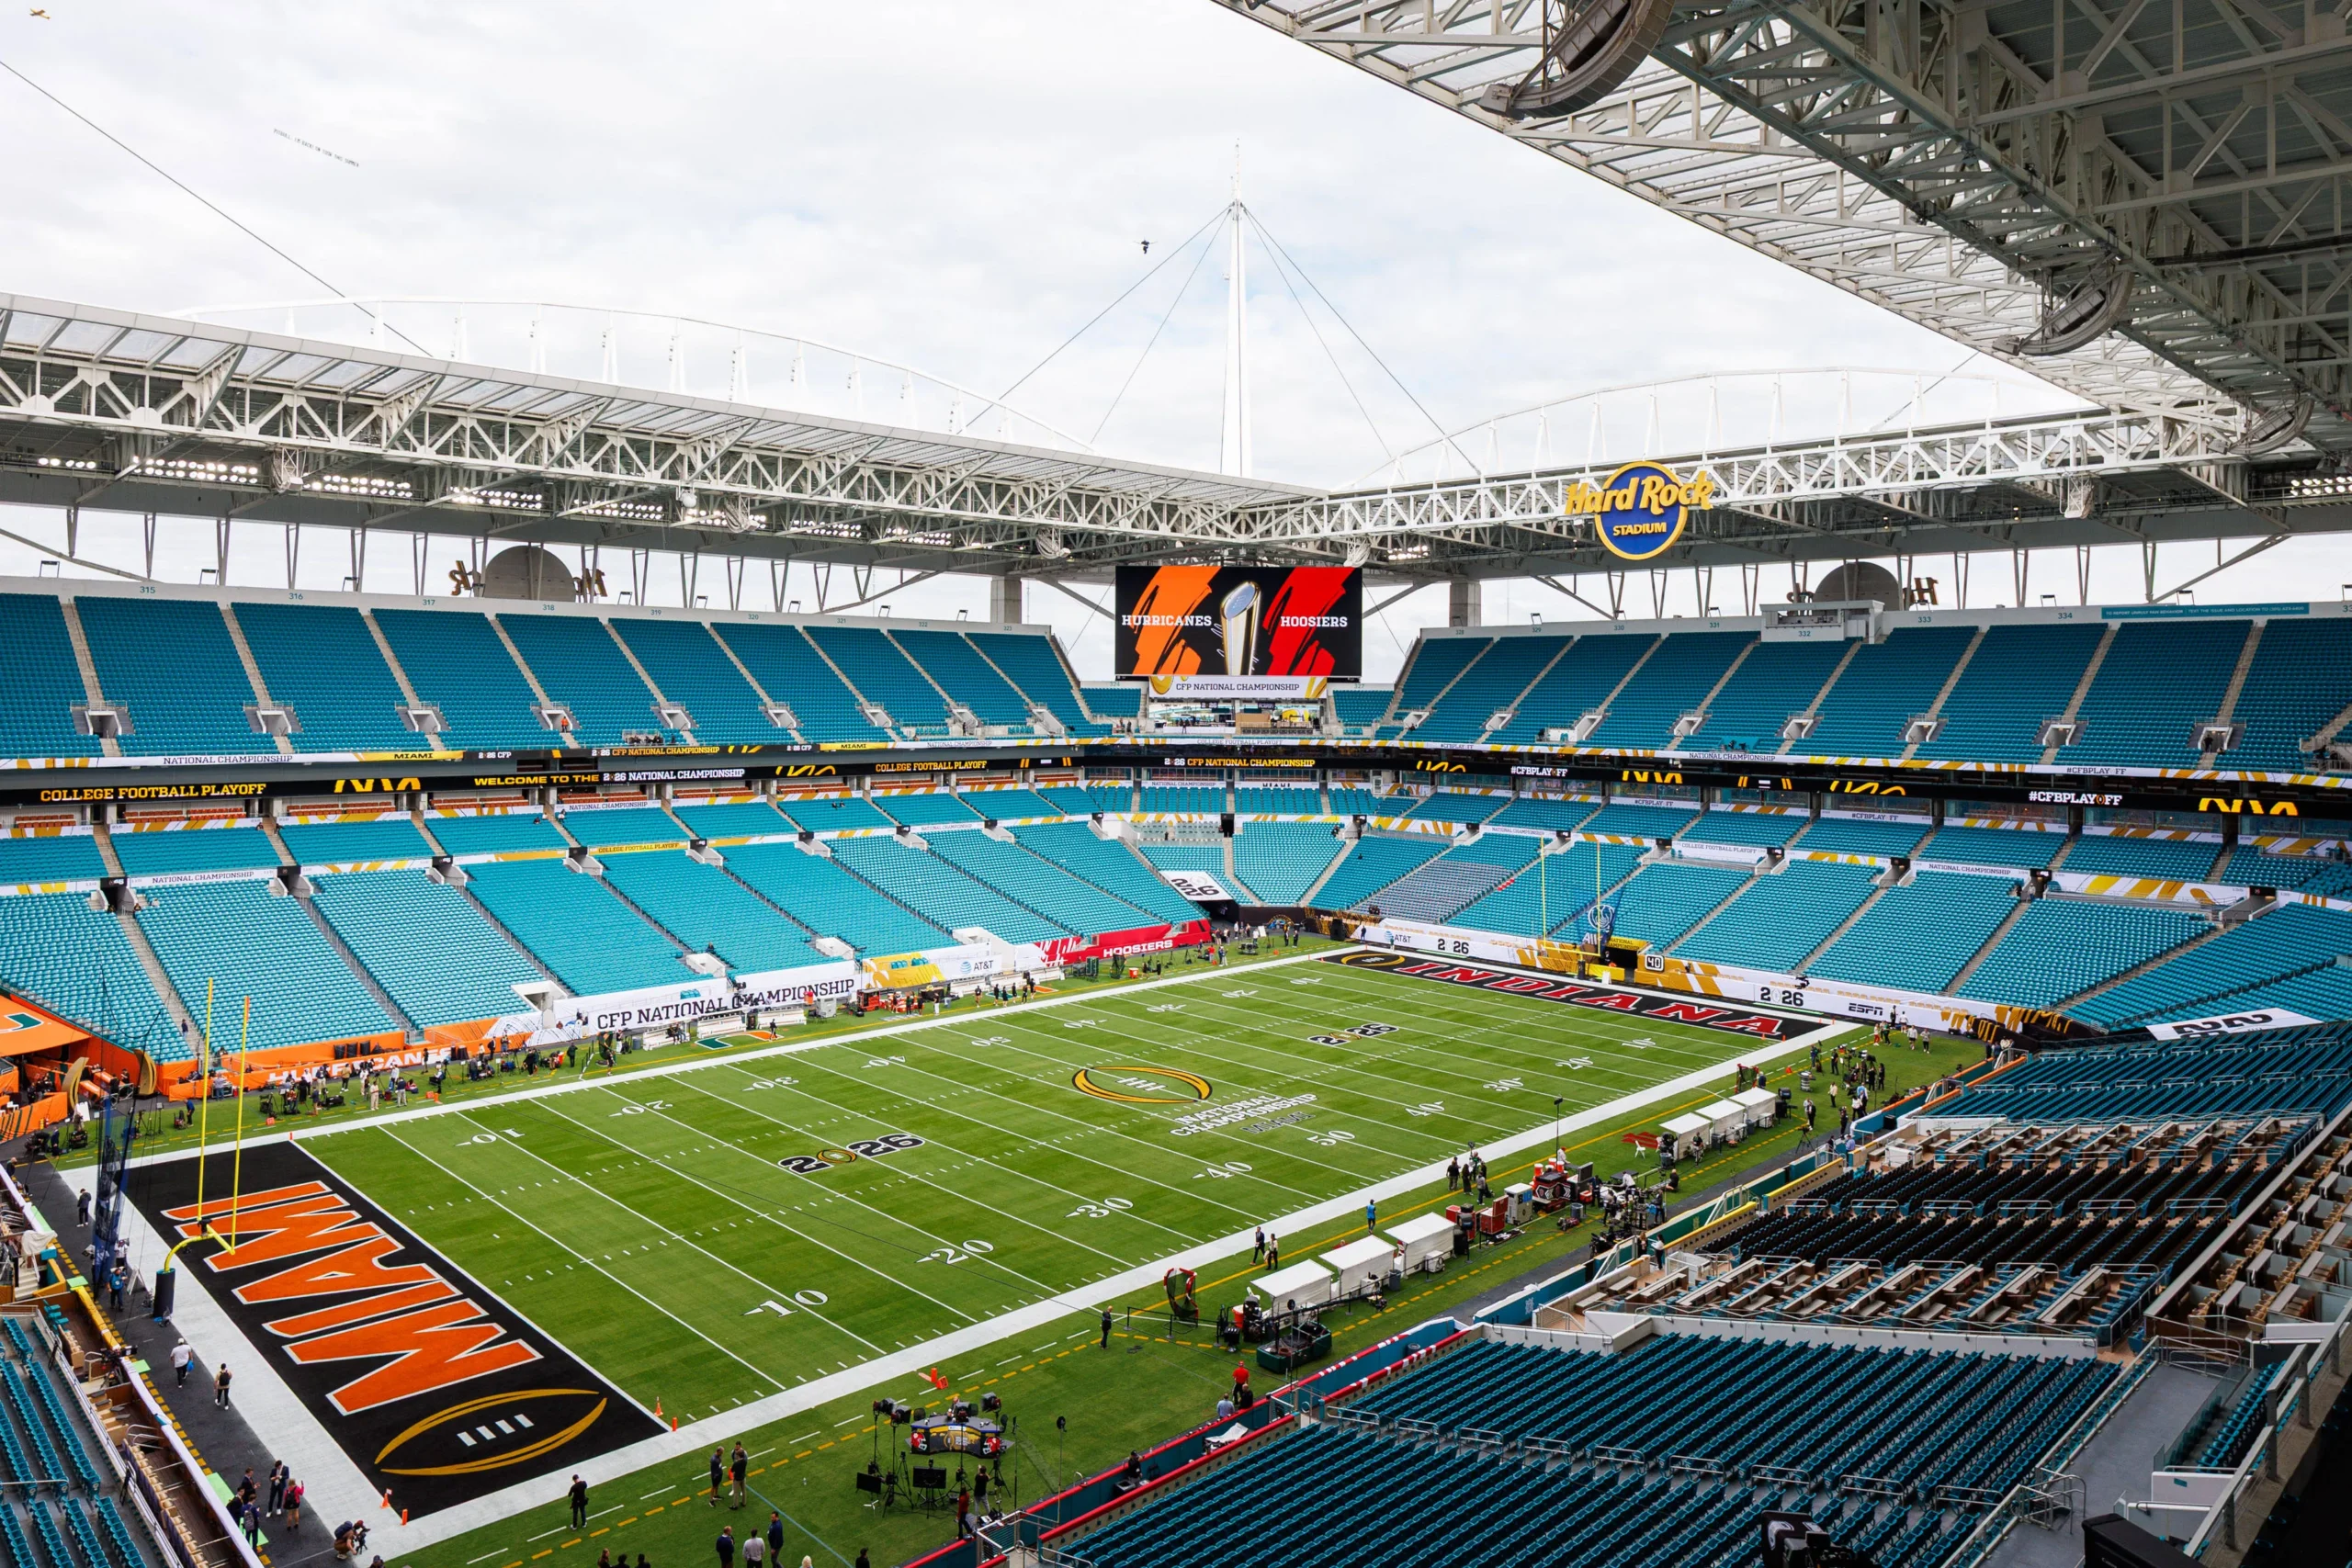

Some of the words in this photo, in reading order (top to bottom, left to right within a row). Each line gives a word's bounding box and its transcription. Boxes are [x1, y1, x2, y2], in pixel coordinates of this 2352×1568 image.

[1565, 477, 1640, 515] Hard
[1639, 470, 1715, 515] Rock
[1612, 522, 1668, 536] STADIUM
[1122, 615, 1213, 627] HURRICANES
[1280, 615, 1349, 627] HOOSIERS
[1175, 682, 1192, 691] CFP
[612, 748, 627, 757] CFP
[628, 747, 666, 755] NATIONAL
[666, 746, 720, 755] CHAMPIONSHIP
[1689, 751, 1723, 761] NATIONAL
[1723, 753, 1776, 761] CHAMPIONSHIP
[164, 755, 216, 765] NATIONAL
[217, 754, 293, 764] CHAMPIONSHIP
[1187, 758, 1204, 766] CFP
[1204, 759, 1250, 767] NATIONAL
[1250, 759, 1316, 768] CHAMPIONSHIP
[876, 762, 912, 773] COLLEGE
[912, 761, 954, 772] FOOTBALL
[954, 761, 988, 770] PLAYOFF
[2066, 765, 2127, 775] #CFBPLAYFF
[474, 775, 548, 786] WELCOME
[571, 773, 600, 783] THE
[628, 771, 676, 781] NATIONAL
[677, 768, 745, 780] CHAMPIONSHIP
[40, 788, 114, 802] COLLEGE
[118, 785, 198, 799] FOOTBALL
[201, 783, 266, 796] PLAYOFF
[569, 803, 600, 811] NATIONAL
[601, 801, 648, 810] CHAMPIONSHIP
[1851, 812, 1899, 821] #CFBPLAYFF
[598, 846, 624, 854] COLLEGE
[1705, 844, 1733, 852] FOOTBALL
[1961, 865, 2011, 875] CHAMPIONSHIP
[152, 874, 194, 884] NATIONAL
[194, 871, 254, 882] CHAMPIONSHIP
[1394, 933, 1411, 944] AT&T
[1102, 939, 1173, 958] HOOSIERS
[973, 959, 993, 972] AT&T
[1394, 961, 1783, 1037] INDIANA
[597, 1010, 633, 1031] CFP
[638, 996, 728, 1024] NATIONAL
[1848, 1002, 1883, 1017] ESPN
[1622, 1038, 1657, 1050] 10
[1555, 1056, 1594, 1071] 20
[1482, 1078, 1524, 1093] 30
[1169, 1093, 1318, 1137] CHAMPIONSHIP
[1172, 1094, 1283, 1124] NATIONAL
[1405, 1101, 1445, 1119] 40
[1240, 1110, 1317, 1135] MIAMI
[1306, 1129, 1356, 1147] 50
[1204, 1160, 1254, 1180] 40
[1076, 1197, 1135, 1219] 30
[929, 1238, 995, 1266] 20
[161, 1179, 545, 1416] MIAMI
[759, 1289, 830, 1318] 10
